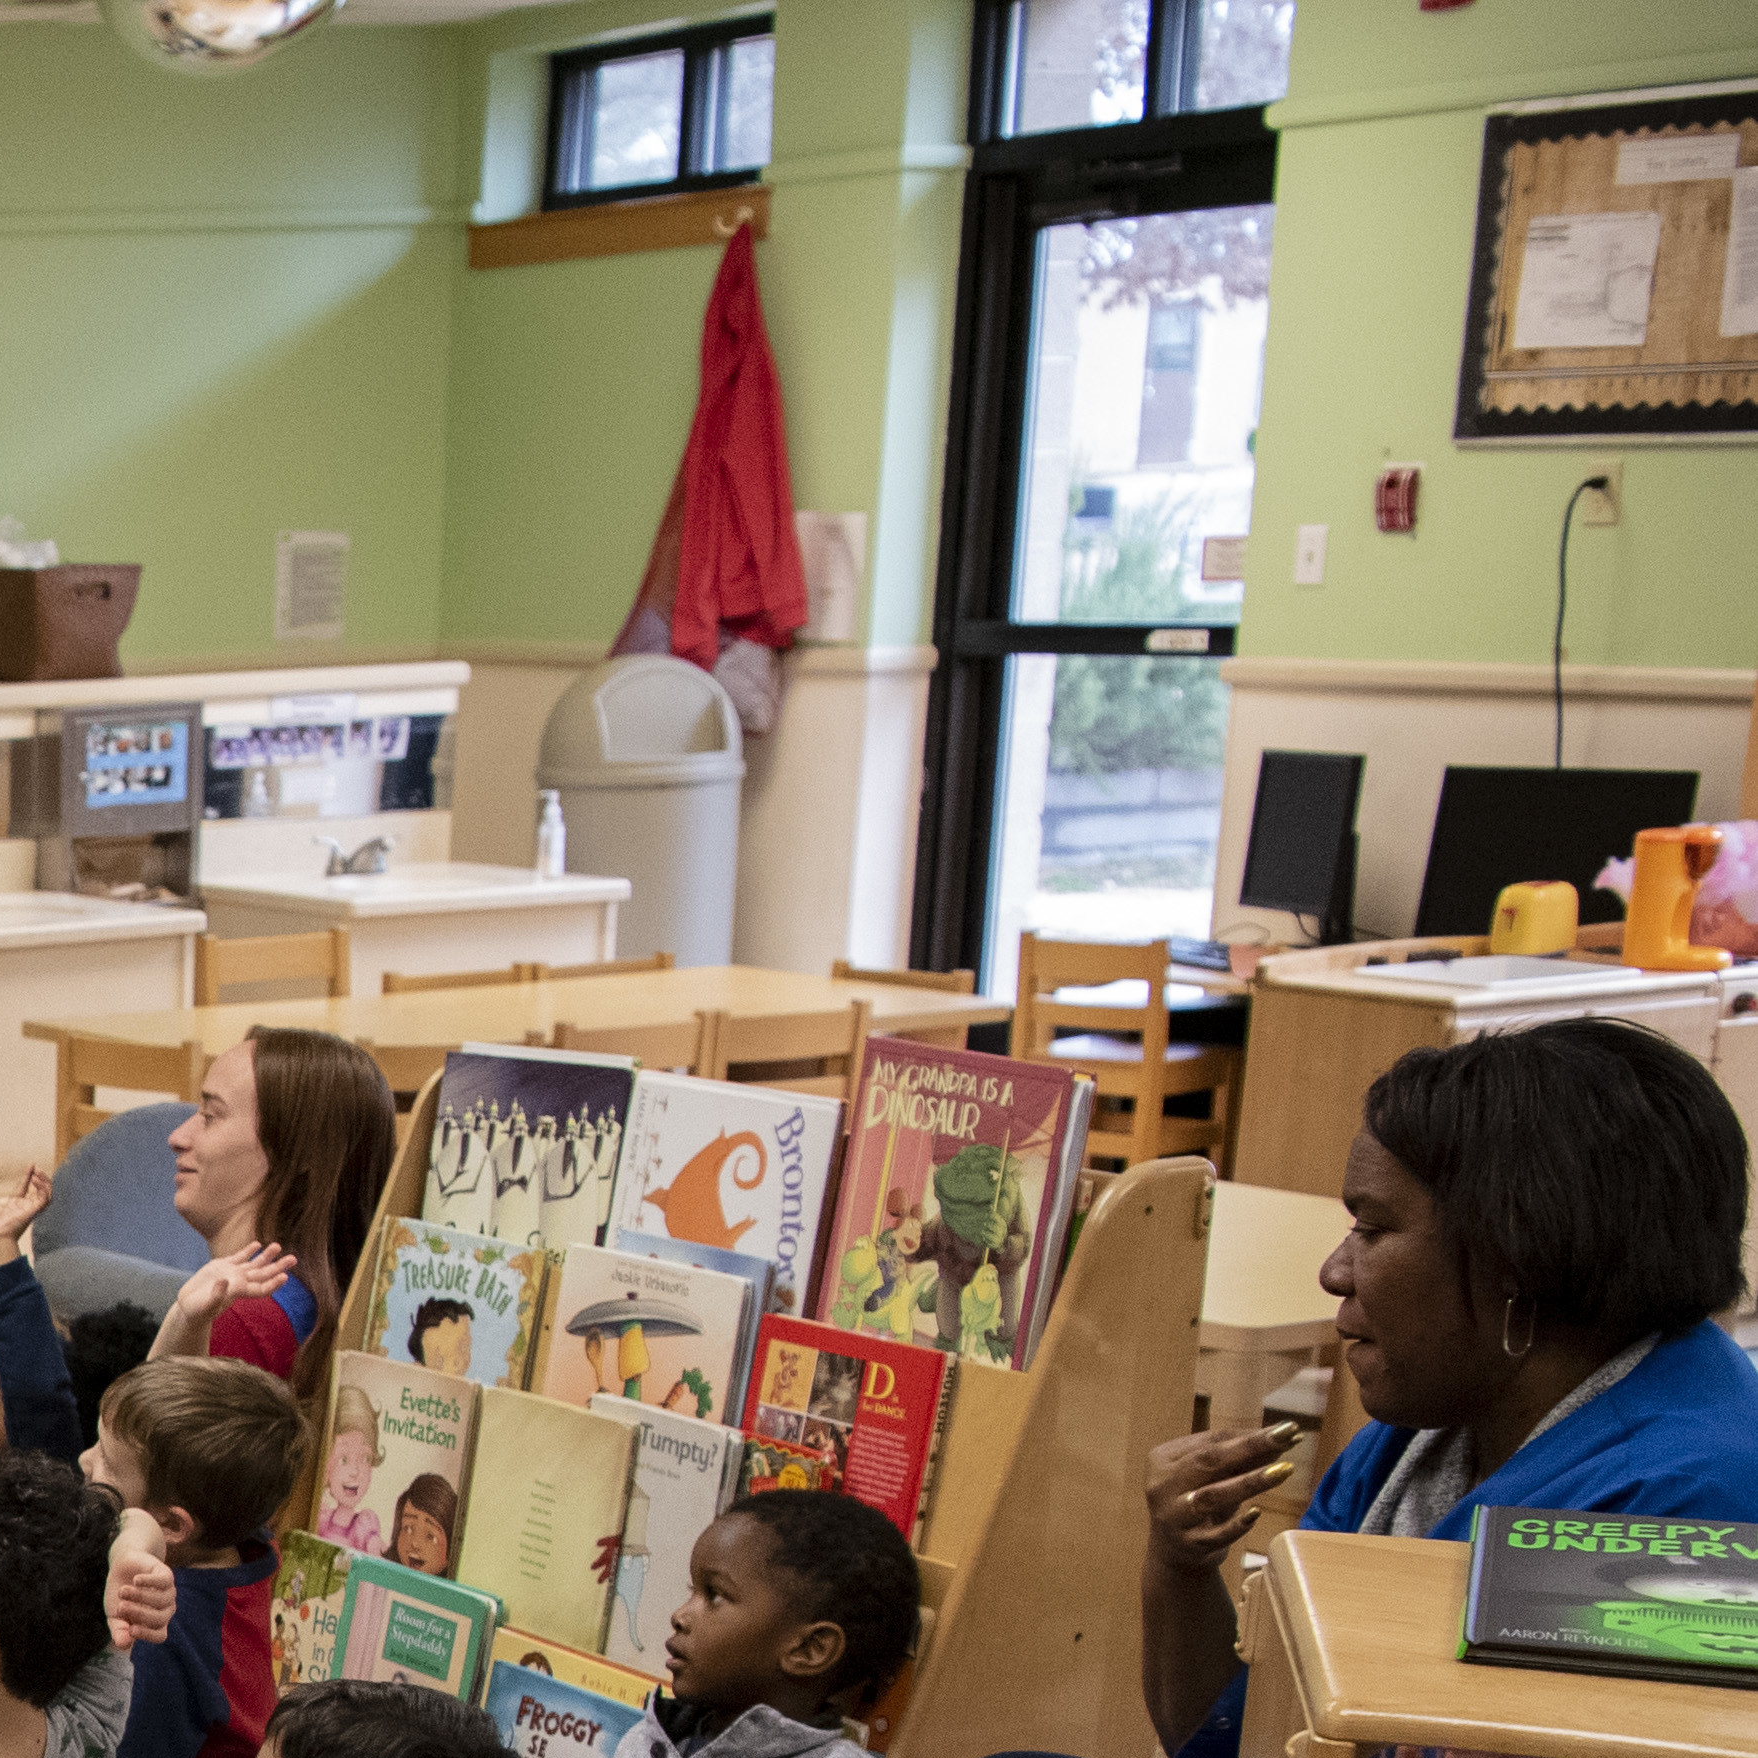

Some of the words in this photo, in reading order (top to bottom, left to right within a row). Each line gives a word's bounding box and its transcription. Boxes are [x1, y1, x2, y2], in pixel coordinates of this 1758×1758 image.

[870, 1056, 898, 1085] MY
[901, 1062, 978, 1099] GRANDPA
[982, 1076, 998, 1102] IS
[1000, 1081, 1015, 1106] A
[865, 1084, 981, 1141] DINOSAUR
[402, 1258, 472, 1294] TREASURE
[475, 1268, 513, 1317] BATH
[864, 1361, 895, 1399] D
[400, 1387, 460, 1423] Evette's
[383, 1411, 457, 1450] Invitation
[640, 1421, 718, 1472] Tumpty?
[1512, 1519, 1735, 1541] CREEPY
[395, 1606, 426, 1630] Room
[390, 1624, 447, 1661] Stepdaddy
[1498, 1626, 1558, 1643] AARON
[1562, 1632, 1649, 1650] REYNOLDS
[516, 1695, 602, 1747] FROGGY
[527, 1734, 548, 1758] SE
